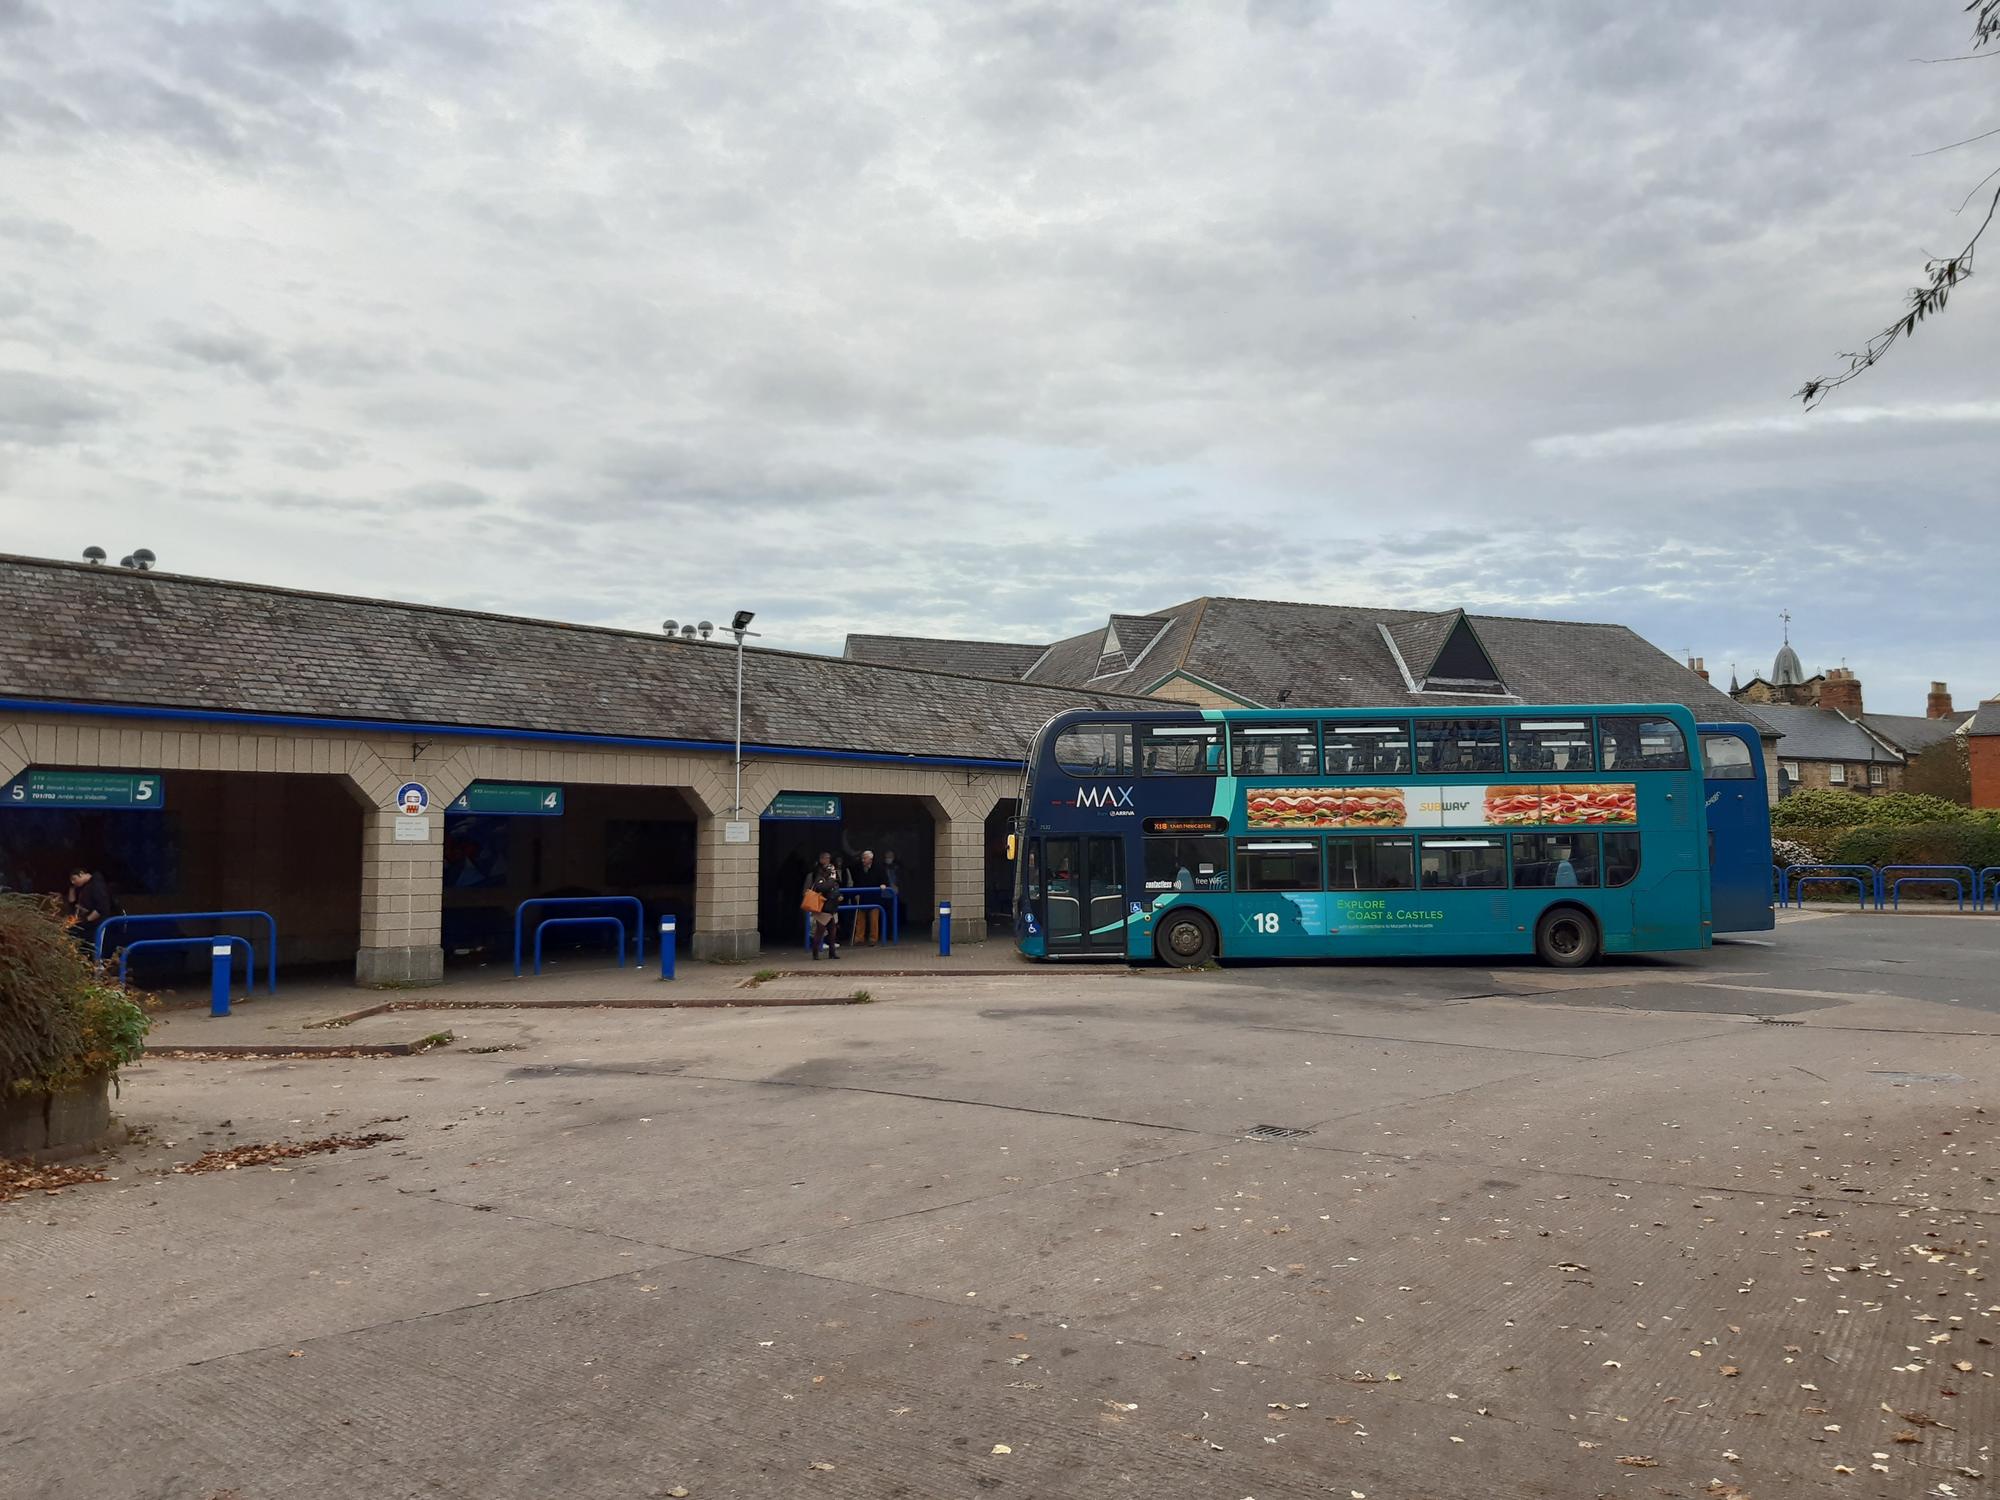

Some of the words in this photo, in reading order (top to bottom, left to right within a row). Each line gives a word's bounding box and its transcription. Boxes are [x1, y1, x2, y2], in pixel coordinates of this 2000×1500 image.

[12, 785, 25, 800] 5
[136, 780, 155, 801] 5
[1076, 786, 1134, 807] MAX
[458, 795, 468, 807] 4
[543, 792, 557, 808] 4
[1418, 801, 1470, 812] SUBWAY
[825, 800, 835, 814] 3
[1145, 880, 1173, 889] contactless
[1195, 877, 1208, 885] free
[1337, 899, 1385, 909] EXPLORE
[1346, 910, 1383, 920] COAST
[1386, 912, 1394, 920] &
[1396, 910, 1444, 920] CASTLES
[1239, 913, 1279, 933] X18
